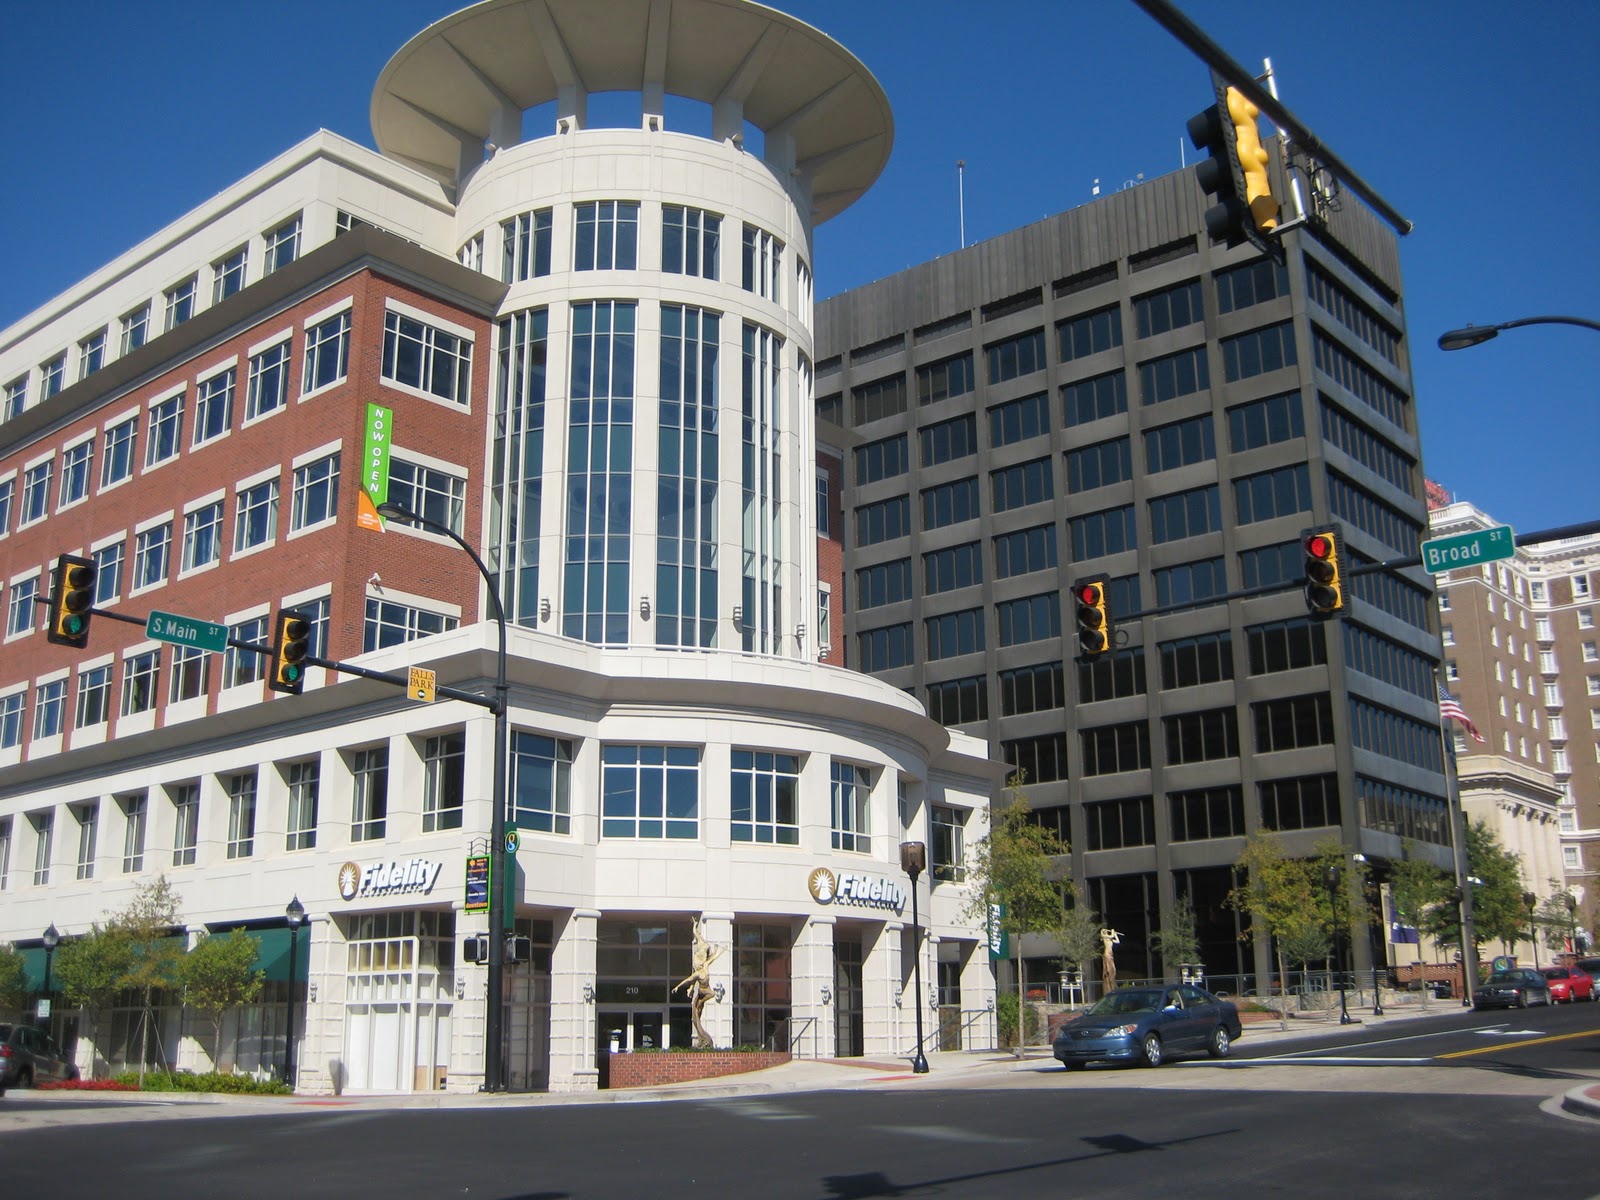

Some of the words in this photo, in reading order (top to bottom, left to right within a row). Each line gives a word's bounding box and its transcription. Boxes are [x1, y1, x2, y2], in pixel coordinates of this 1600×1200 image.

[373, 408, 384, 442] NOW
[370, 447, 382, 493] OPEN
[1429, 540, 1480, 565] Broad
[1490, 531, 1502, 541] ST
[209, 627, 219, 636] ST
[410, 668, 434, 680] FALLS
[410, 677, 434, 690] PARK
[359, 859, 442, 893] Fidelity
[836, 873, 906, 913] Fidelity
